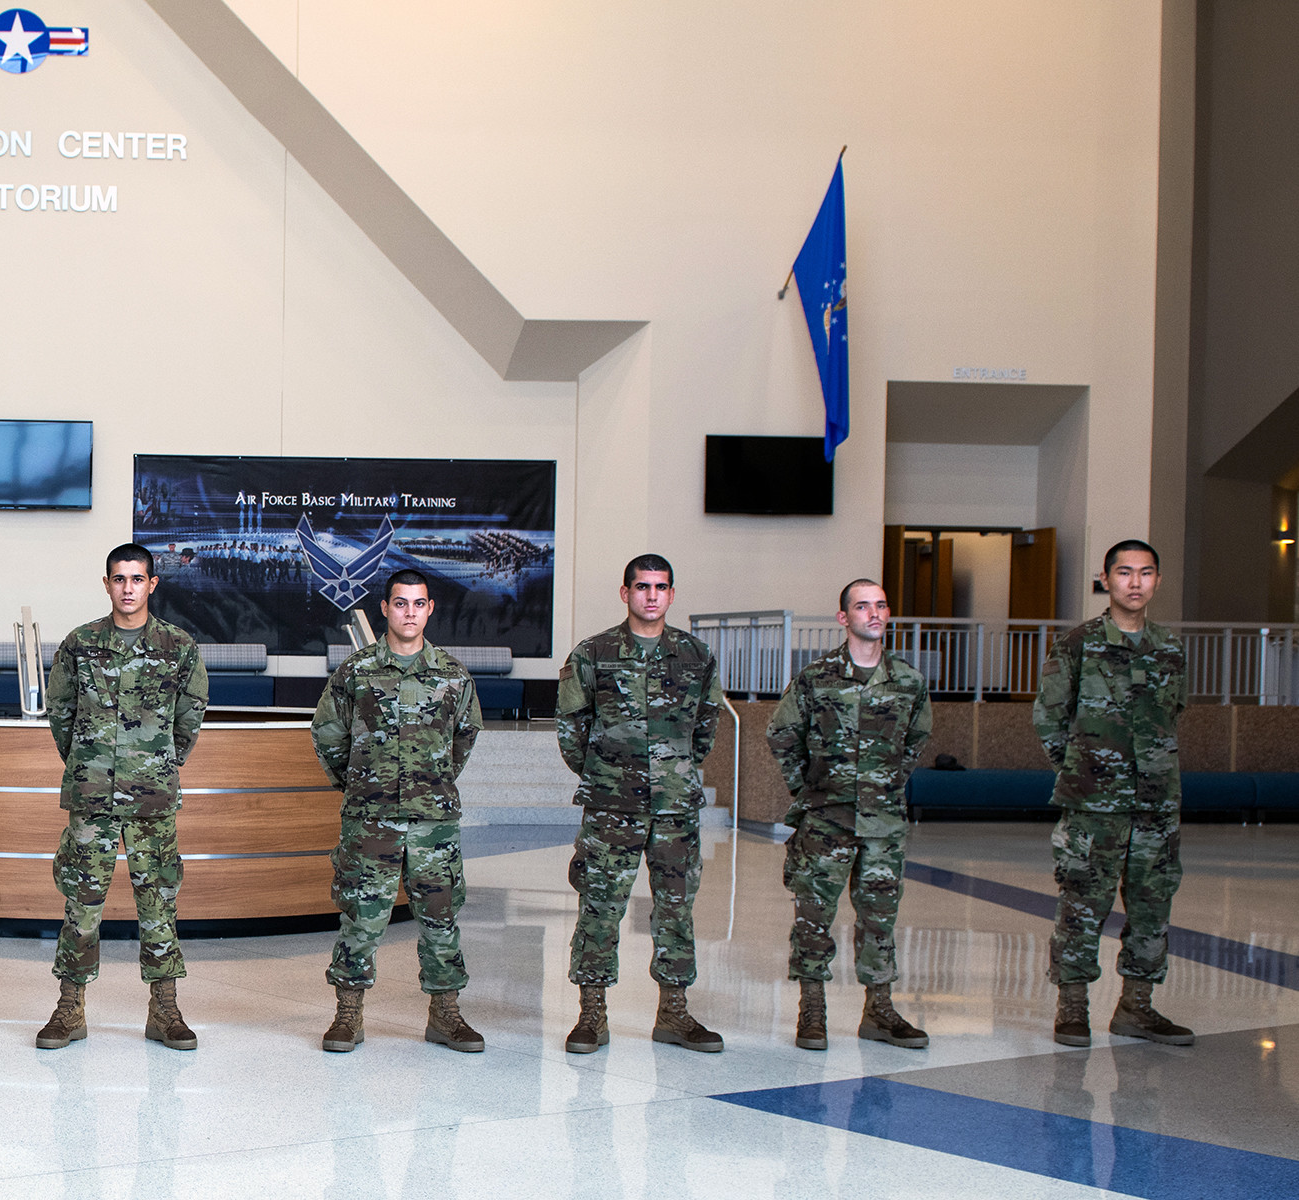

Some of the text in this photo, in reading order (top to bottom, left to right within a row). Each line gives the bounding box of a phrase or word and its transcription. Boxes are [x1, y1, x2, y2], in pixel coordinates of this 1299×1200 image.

[57, 130, 188, 161] CENTER
[953, 366, 1027, 380] ENTRANCE
[235, 491, 457, 508] AIR FORCE BASIC MILITARY TRAINING
